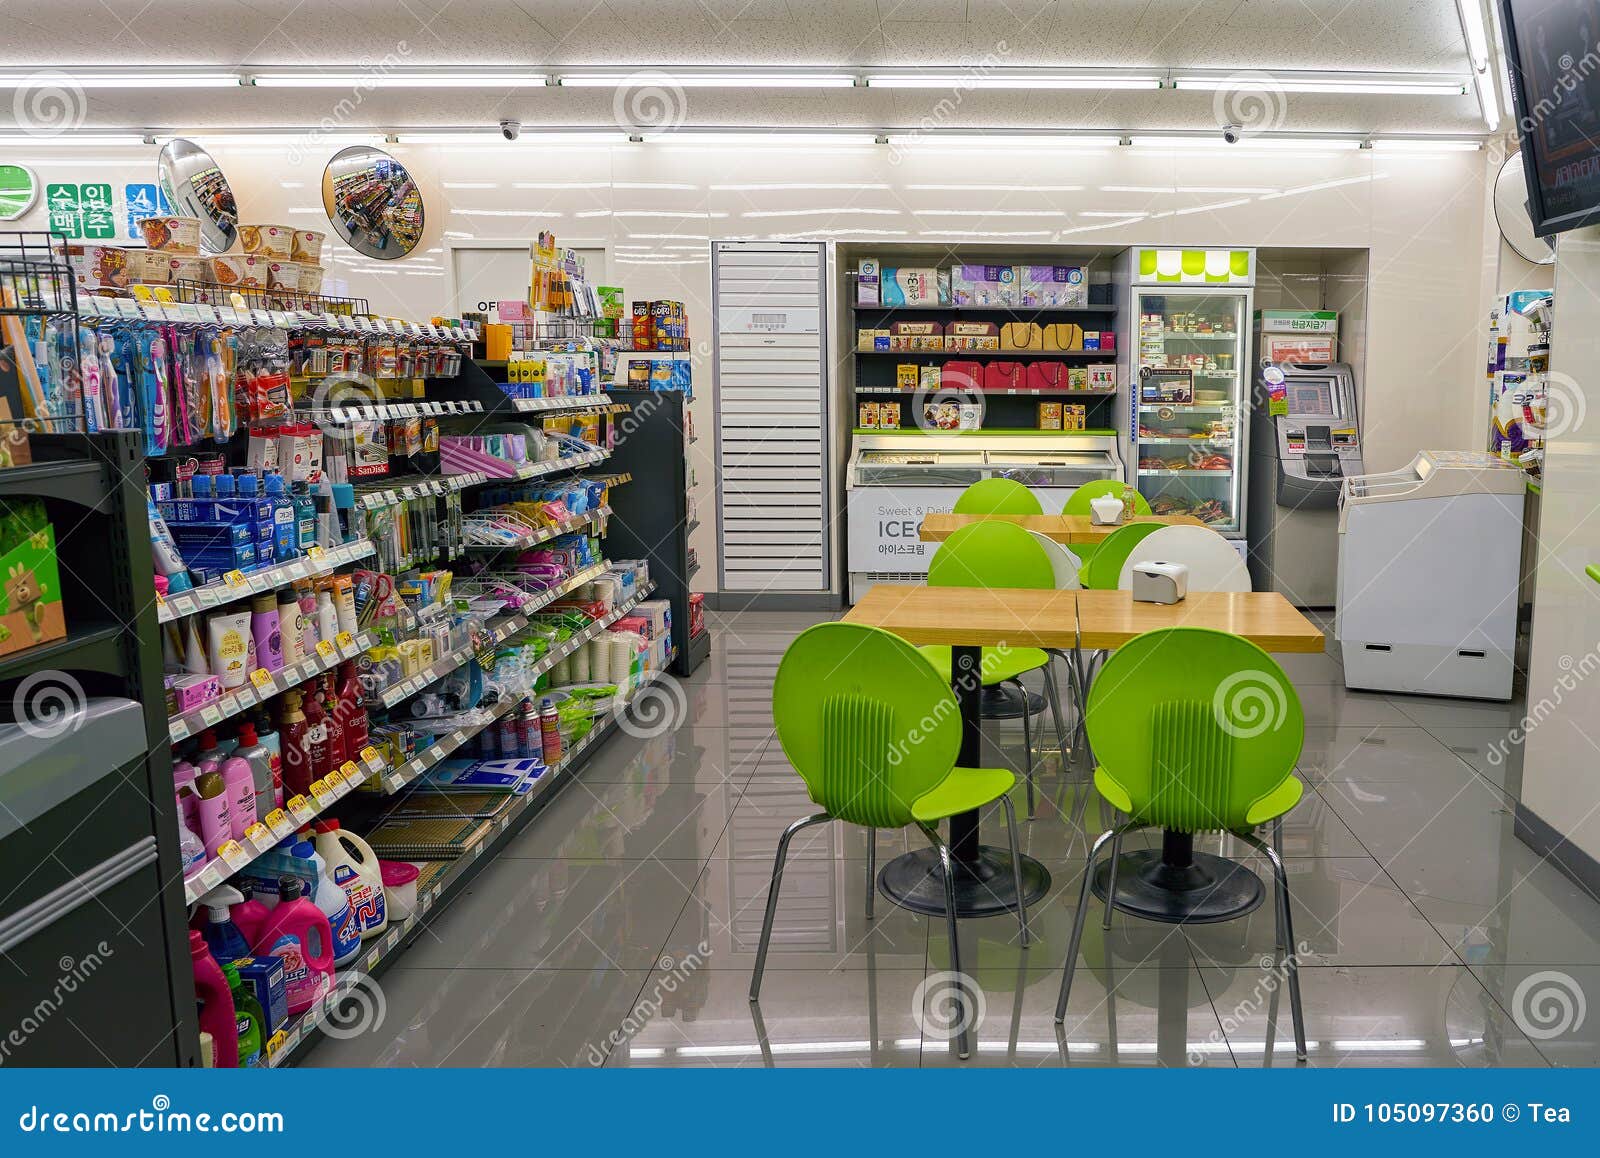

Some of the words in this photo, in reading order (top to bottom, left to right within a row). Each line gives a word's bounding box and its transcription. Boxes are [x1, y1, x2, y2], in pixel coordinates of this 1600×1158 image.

[54, 213, 108, 237] 맥주
[478, 301, 500, 312] OF
[1291, 319, 1327, 330] 현금지급기
[357, 465, 387, 476] SanDisk
[878, 506, 912, 516] Sweet
[916, 506, 924, 516] &
[878, 543, 925, 556] 아이스크림
